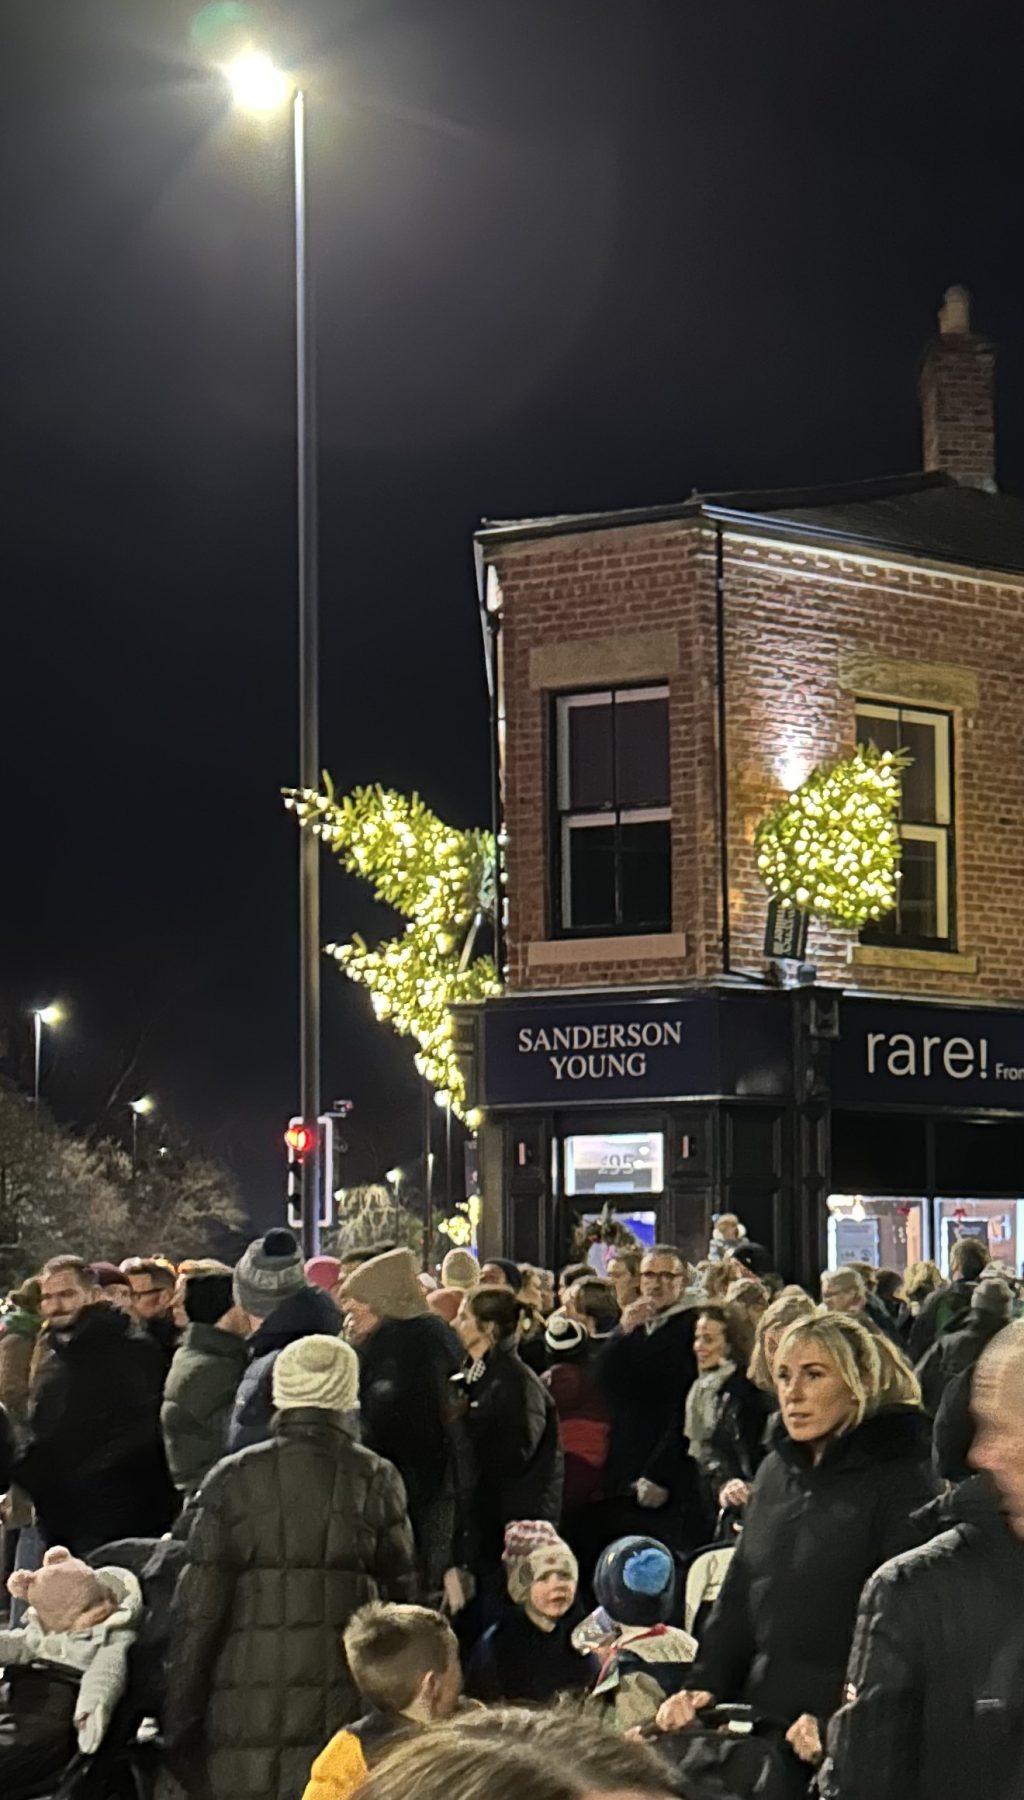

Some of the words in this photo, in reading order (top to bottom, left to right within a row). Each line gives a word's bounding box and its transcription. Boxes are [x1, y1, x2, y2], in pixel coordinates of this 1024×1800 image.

[518, 1020, 683, 1052] SANDERSON
[549, 1052, 647, 1080] YOUNG
[866, 1032, 988, 1079] rare!
